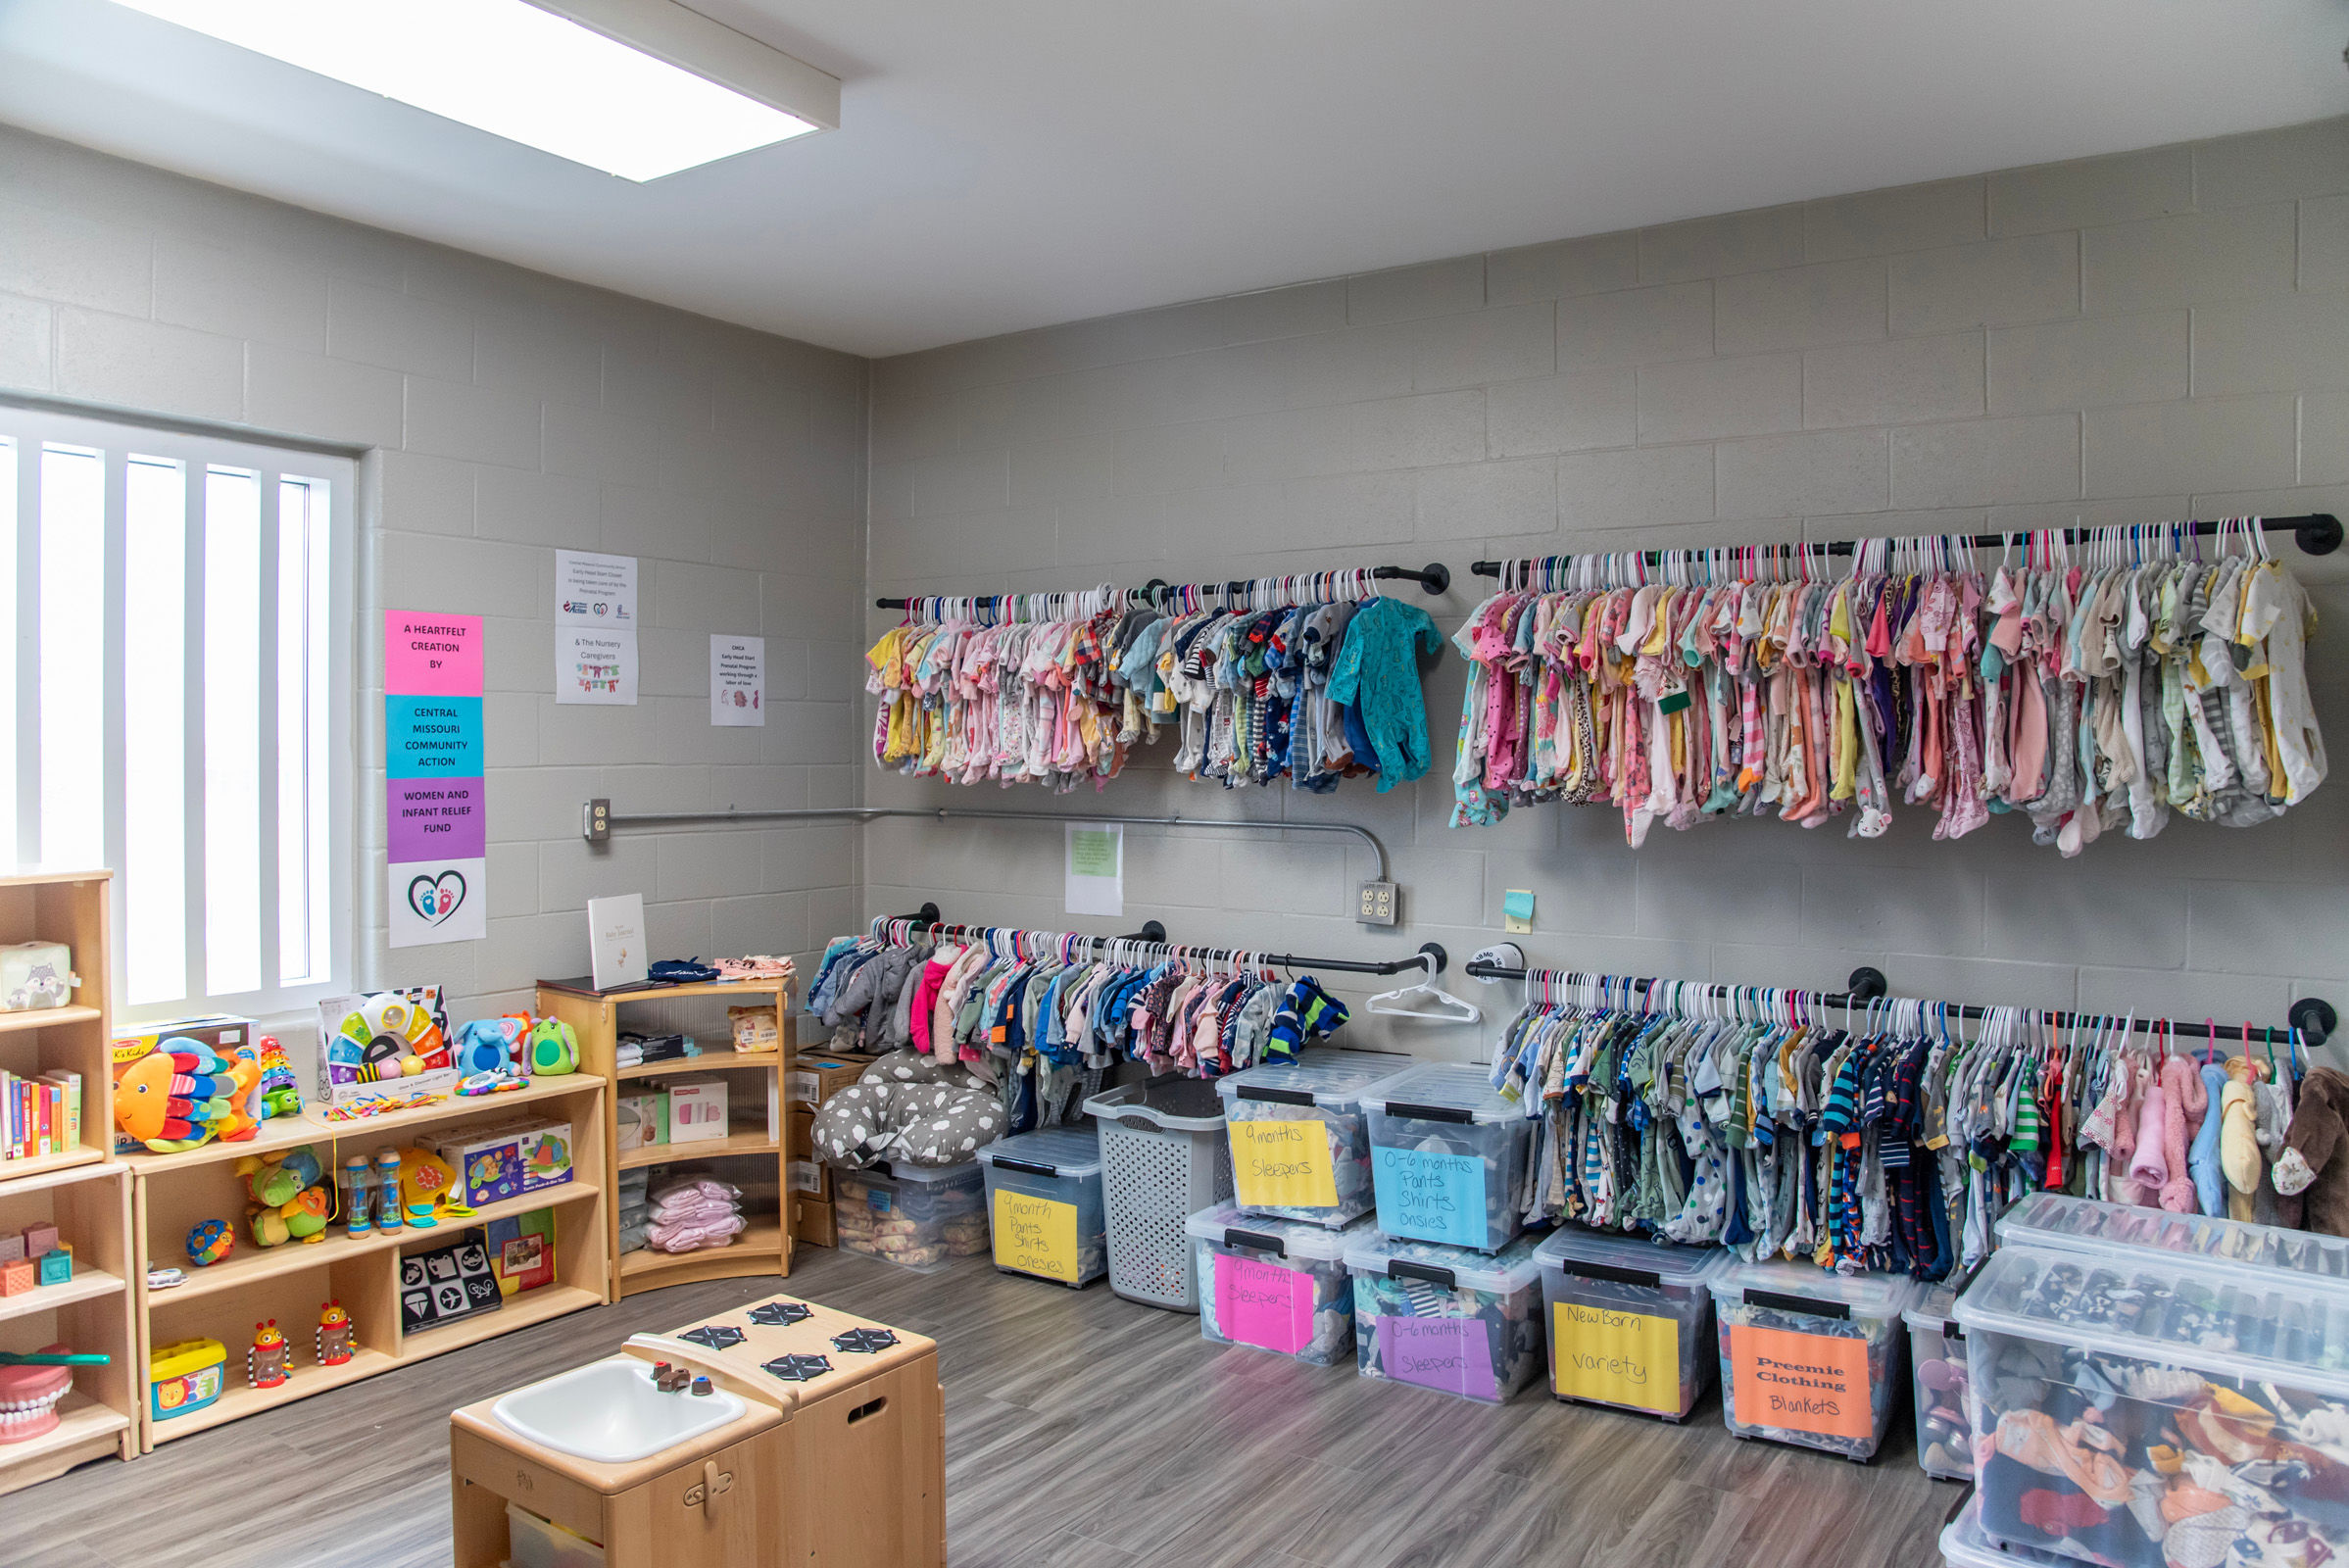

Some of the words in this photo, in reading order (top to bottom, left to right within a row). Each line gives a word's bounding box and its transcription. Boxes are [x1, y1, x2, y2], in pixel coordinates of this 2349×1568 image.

[404, 624, 412, 633] A
[415, 625, 466, 637] HEARTFELT
[412, 642, 460, 652] CREATION
[596, 640, 621, 649] Nursery
[430, 660, 442, 668] BY
[580, 652, 615, 661] Caregivers
[415, 708, 458, 717] CENTRAL
[413, 725, 460, 734] MISSOURI
[405, 741, 468, 750] COMMUNITY
[418, 758, 456, 766] ACTION
[447, 790, 469, 799] AND
[402, 808, 438, 817] INFANT
[441, 807, 471, 815] RELIEF
[424, 823, 451, 833] FUND
[1251, 1158, 1312, 1179] Sleepers
[1385, 1152, 1415, 1167] 0-6
[1423, 1157, 1473, 1173] months
[1399, 1170, 1444, 1189] Pants
[1397, 1190, 1455, 1211] Shirts
[1009, 1216, 1042, 1234] Pants
[1015, 1235, 1050, 1252] Shirts
[1228, 1284, 1296, 1308] Sleepers
[1392, 1321, 1419, 1338] 0-6
[1422, 1322, 1469, 1337] months
[1402, 1356, 1468, 1373] Sleepers
[1573, 1352, 1646, 1385] Variety
[1756, 1357, 1844, 1376] Preemie
[1756, 1372, 1846, 1393] Clothing
[1770, 1396, 1840, 1415] Blankets
